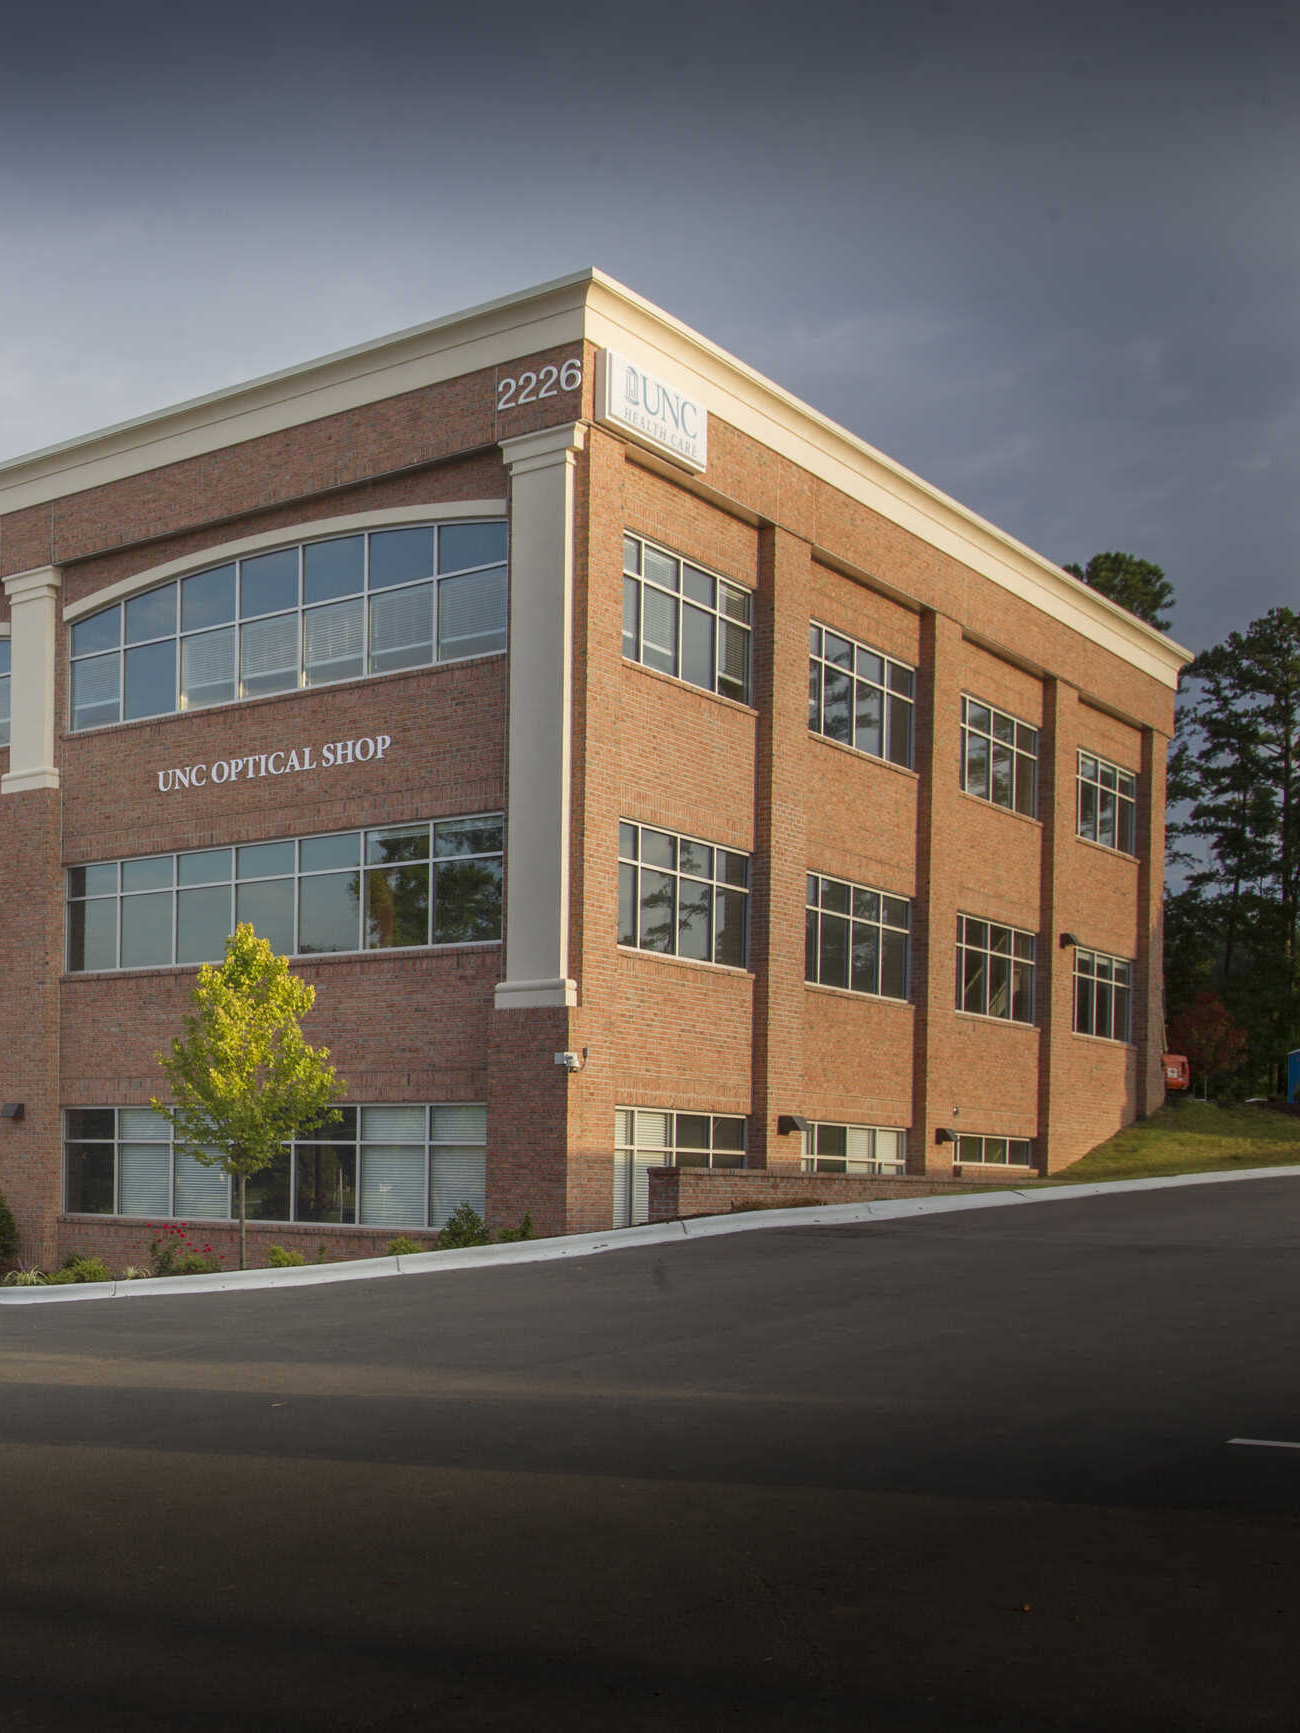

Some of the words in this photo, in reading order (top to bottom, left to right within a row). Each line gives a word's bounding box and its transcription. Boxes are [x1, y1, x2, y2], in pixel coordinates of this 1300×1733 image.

[497, 359, 582, 411] 2226
[642, 375, 698, 439] UNC
[624, 407, 667, 441] HEALTH
[670, 432, 698, 458] CARE
[157, 764, 207, 792] UNC
[211, 747, 317, 784] OPTICAL
[322, 735, 391, 767] SHOP
